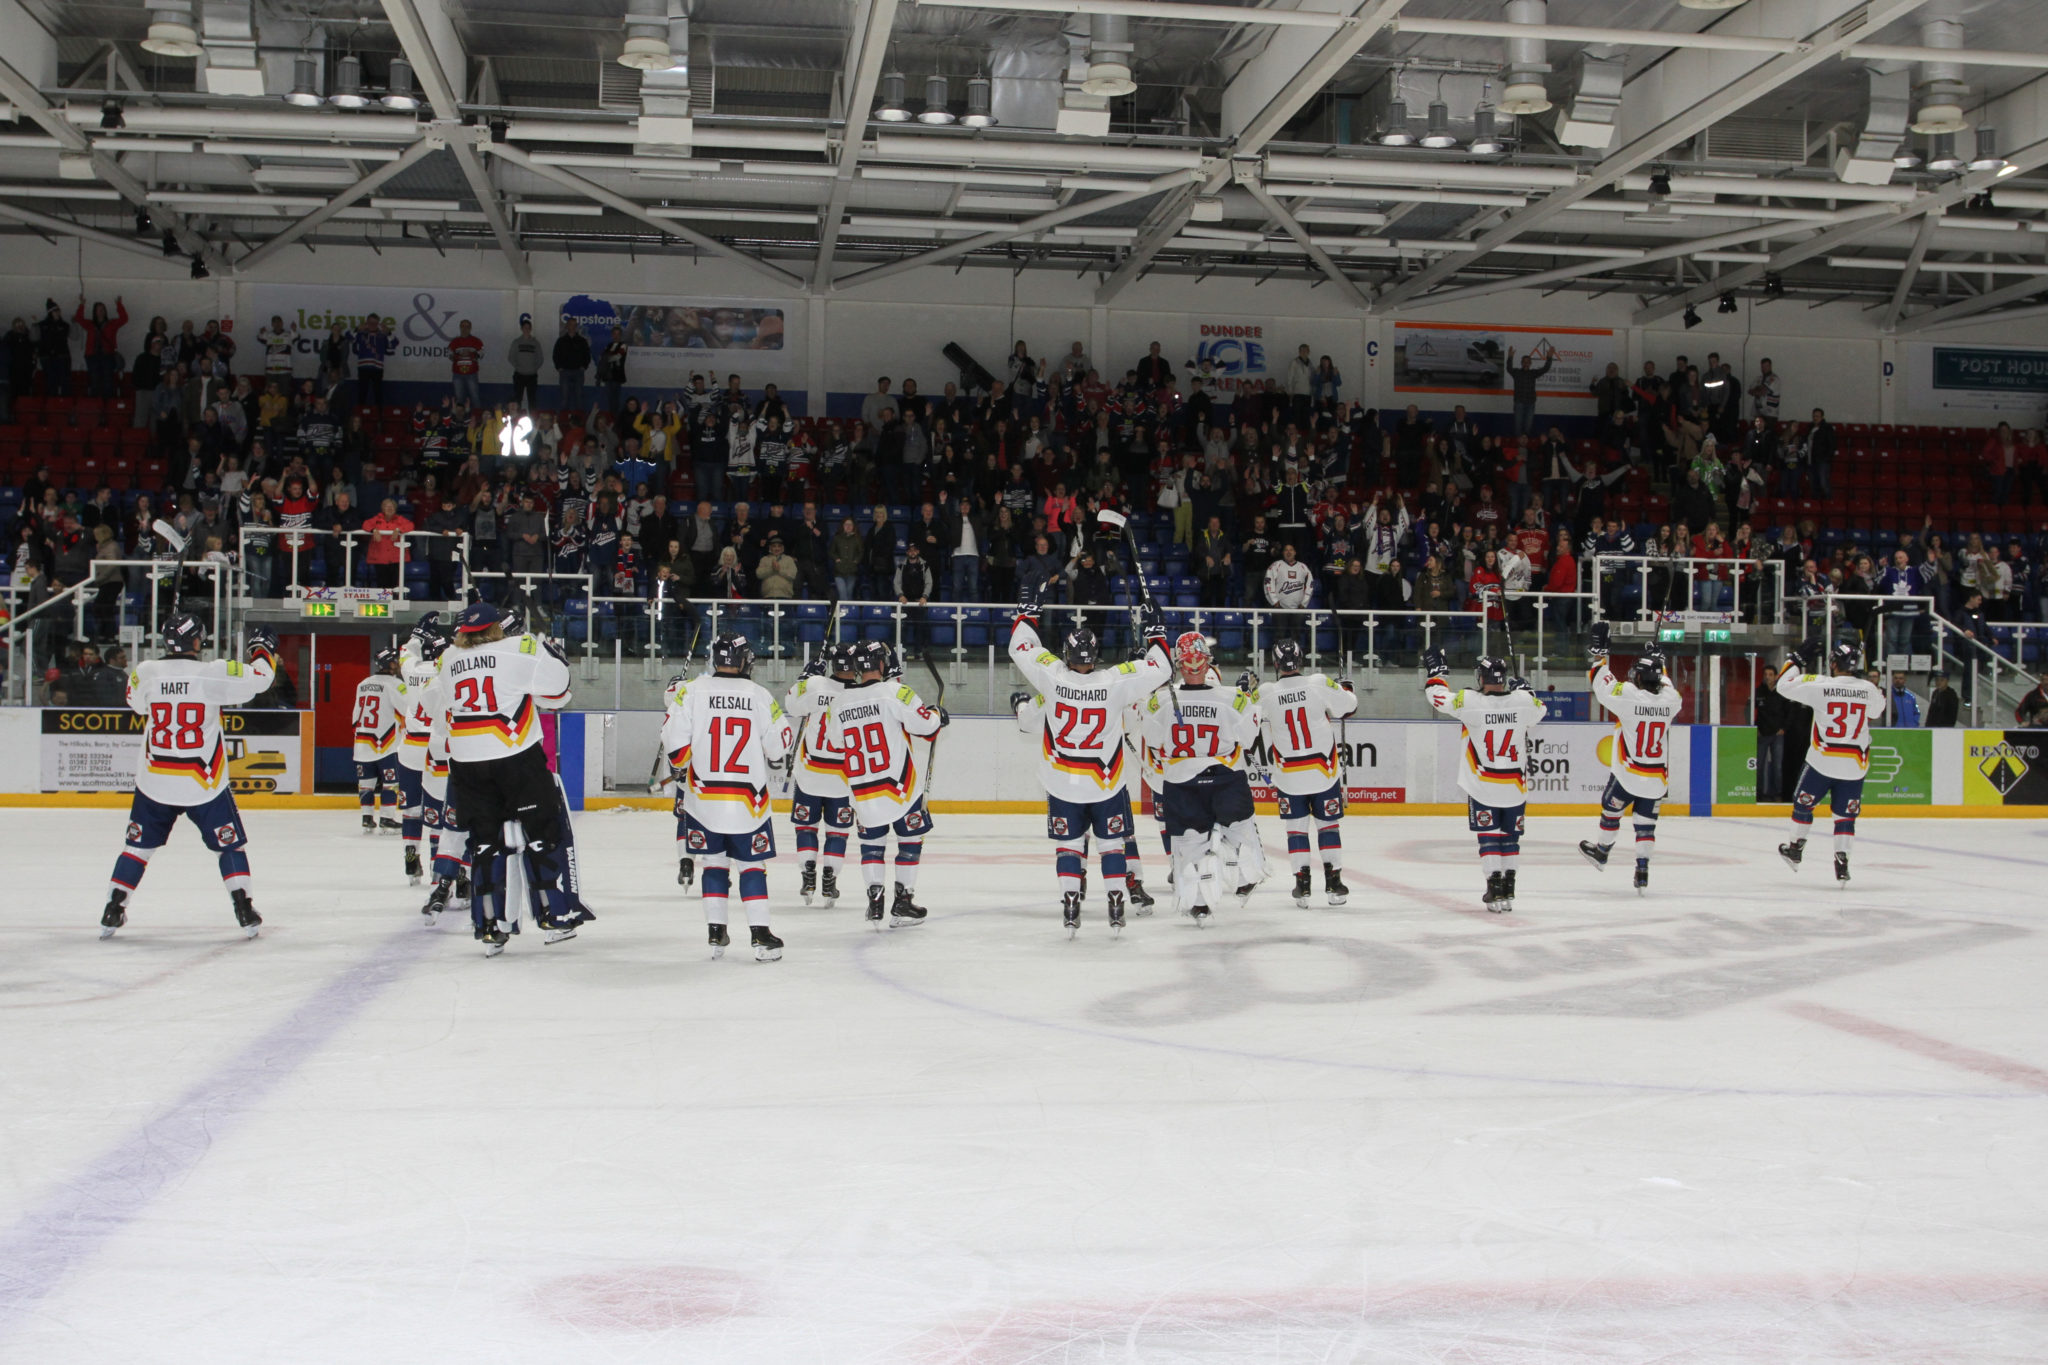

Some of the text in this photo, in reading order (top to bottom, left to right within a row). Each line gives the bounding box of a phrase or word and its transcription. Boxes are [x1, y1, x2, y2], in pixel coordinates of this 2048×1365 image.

[298, 310, 396, 330] leisue
[1200, 325, 1262, 337] DUNDEE
[403, 346, 449, 357] DUNDE
[1197, 339, 1266, 375] ICE
[1367, 341, 1379, 356] C
[1883, 362, 1893, 376] D
[1959, 359, 2001, 374] POST
[450, 655, 496, 677] HOLLAND
[161, 682, 190, 695] HART
[1823, 688, 1869, 699] MARQUARDT
[709, 696, 752, 711] KELSALL
[1278, 691, 1307, 705] INGLIS
[1485, 712, 1517, 725] COWNIE
[1634, 705, 1670, 717] LUNDVALD
[59, 713, 123, 731] SCOTT
[151, 702, 205, 749] 88
[1055, 701, 1107, 750] 22
[1284, 706, 1313, 750] 11
[1825, 701, 1866, 740] 37
[708, 716, 751, 774] 12
[1171, 723, 1220, 757] 87
[1483, 728, 1518, 762] 14
[1543, 741, 1569, 755] and
[1635, 720, 1666, 758] 10
[843, 721, 891, 778] 89
[1970, 745, 2040, 759] RENOVO
[566, 846, 578, 894] VAUGHN
